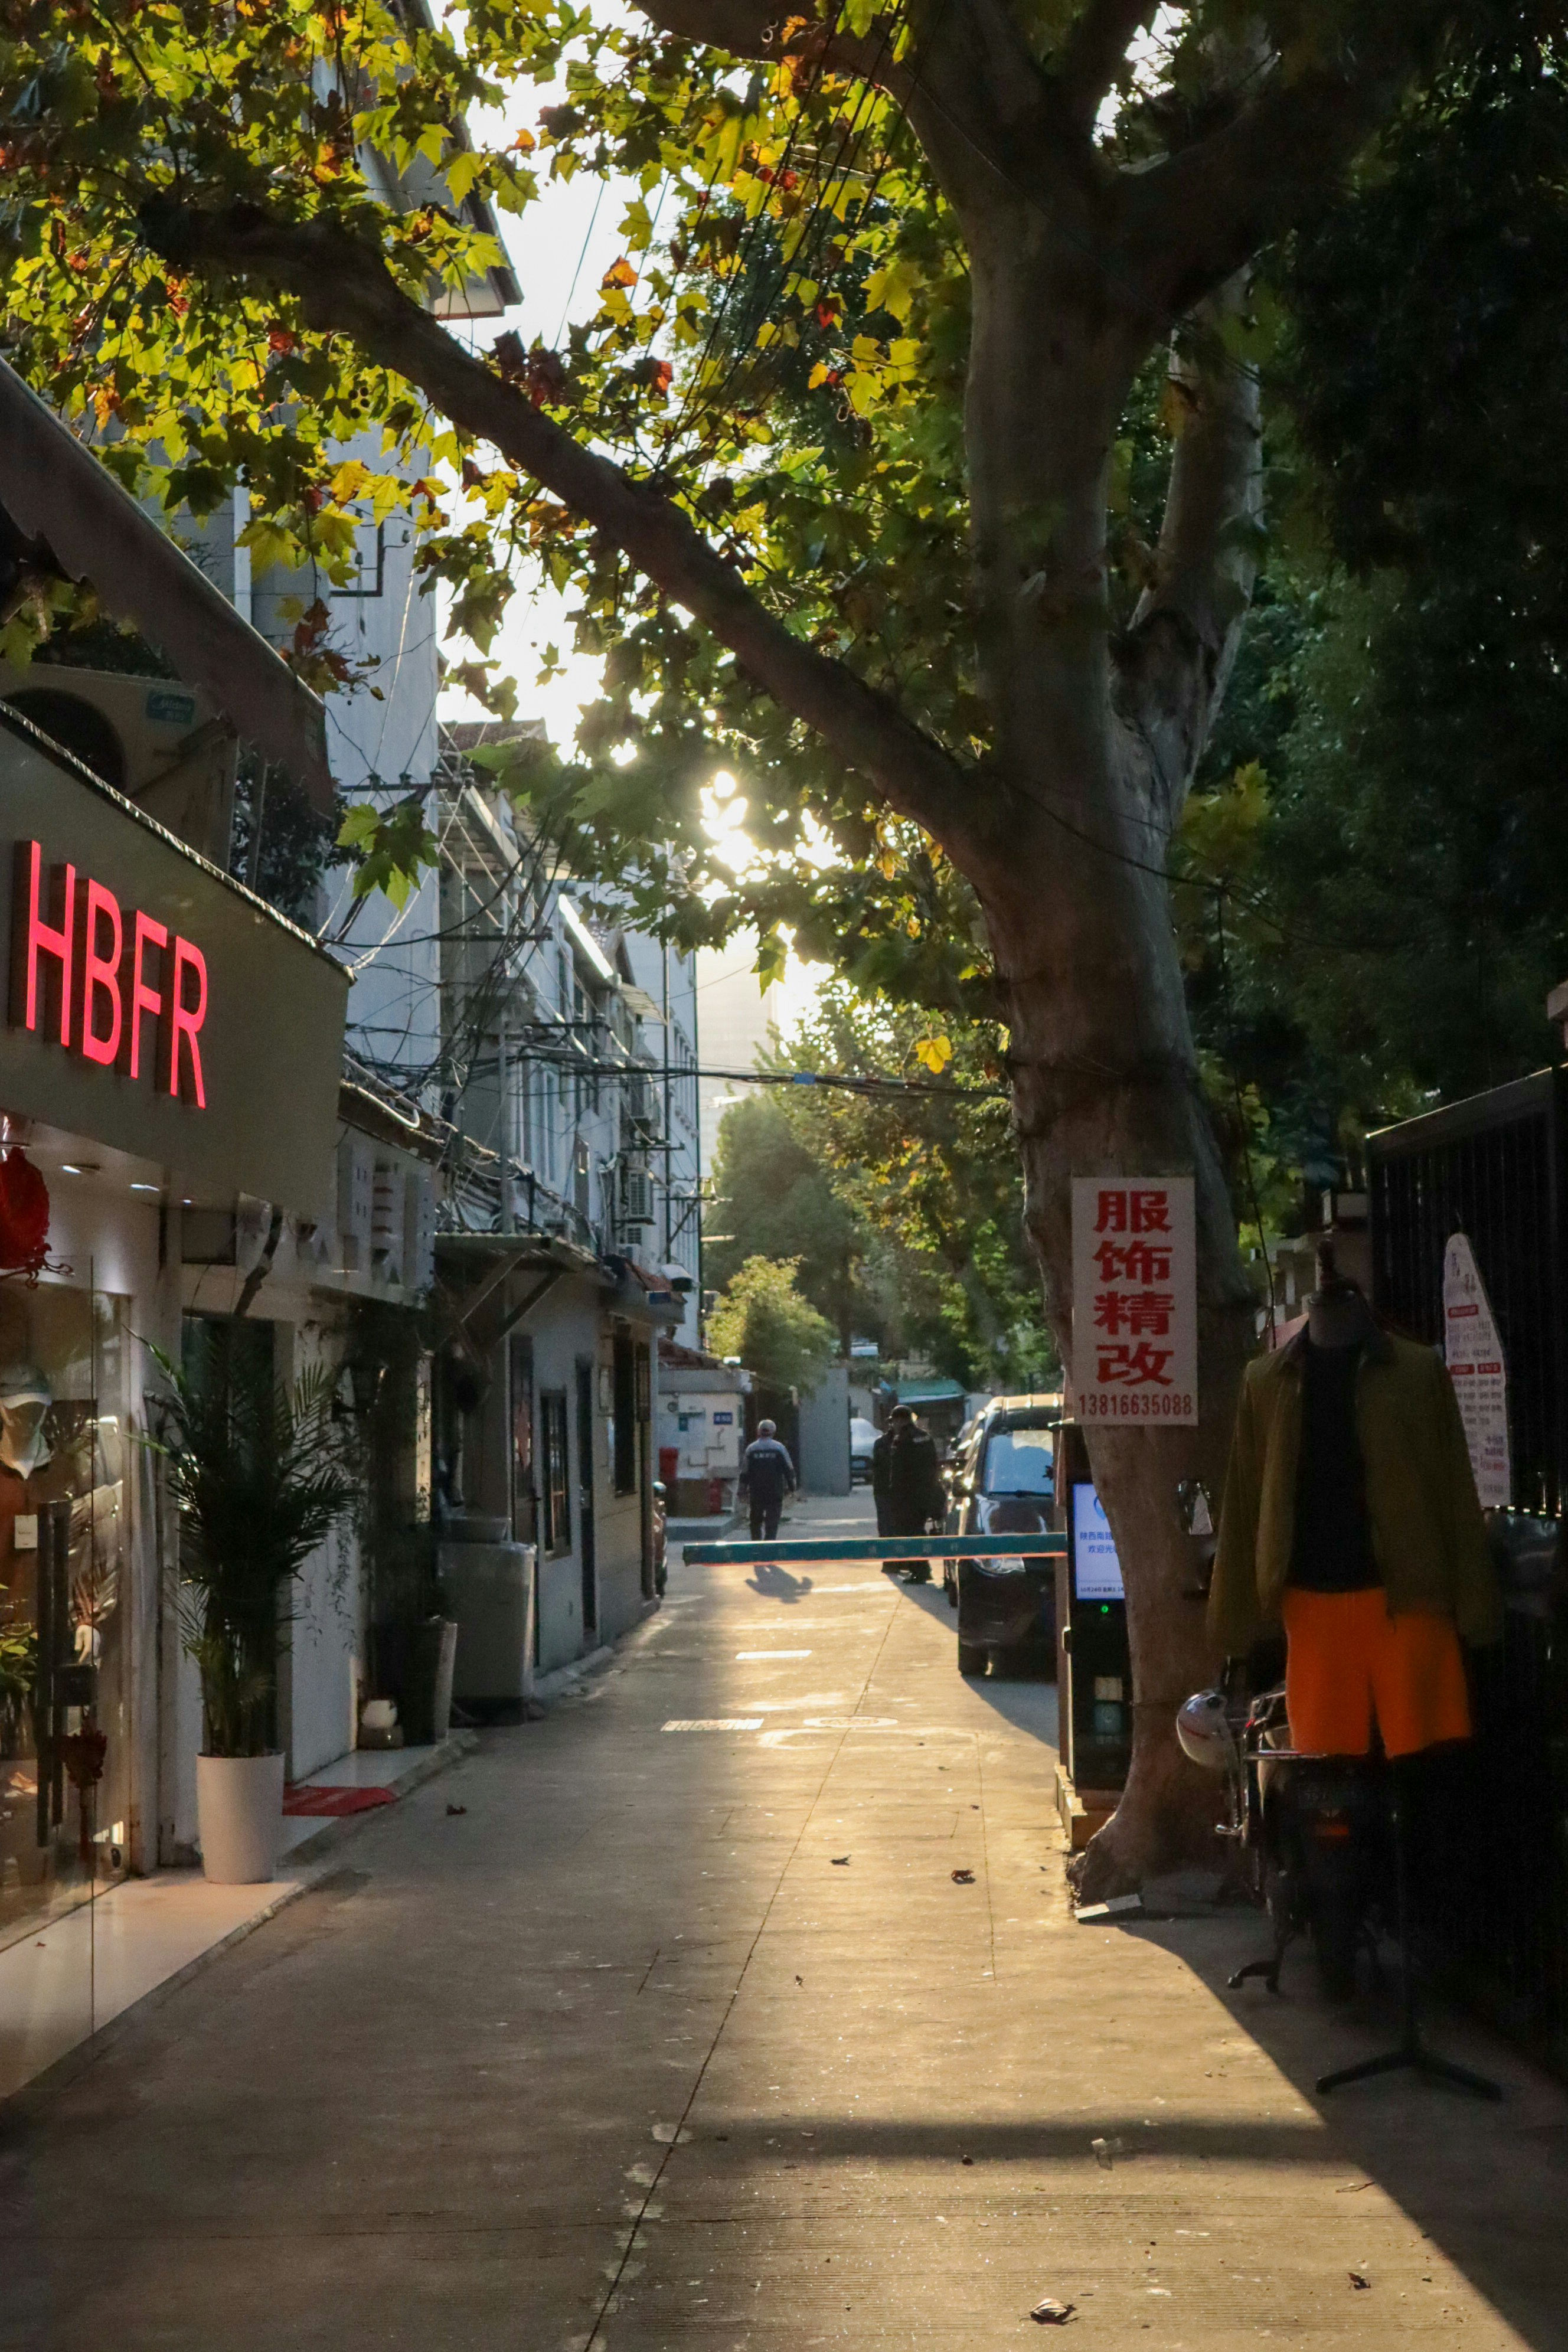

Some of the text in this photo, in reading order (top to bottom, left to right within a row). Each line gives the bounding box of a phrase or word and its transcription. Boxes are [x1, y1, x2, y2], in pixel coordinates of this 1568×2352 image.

[26, 840, 206, 1109] HBFR
[1093, 1190, 1174, 1387] 服饰精改
[1079, 1394, 1191, 1416] 13816635088
